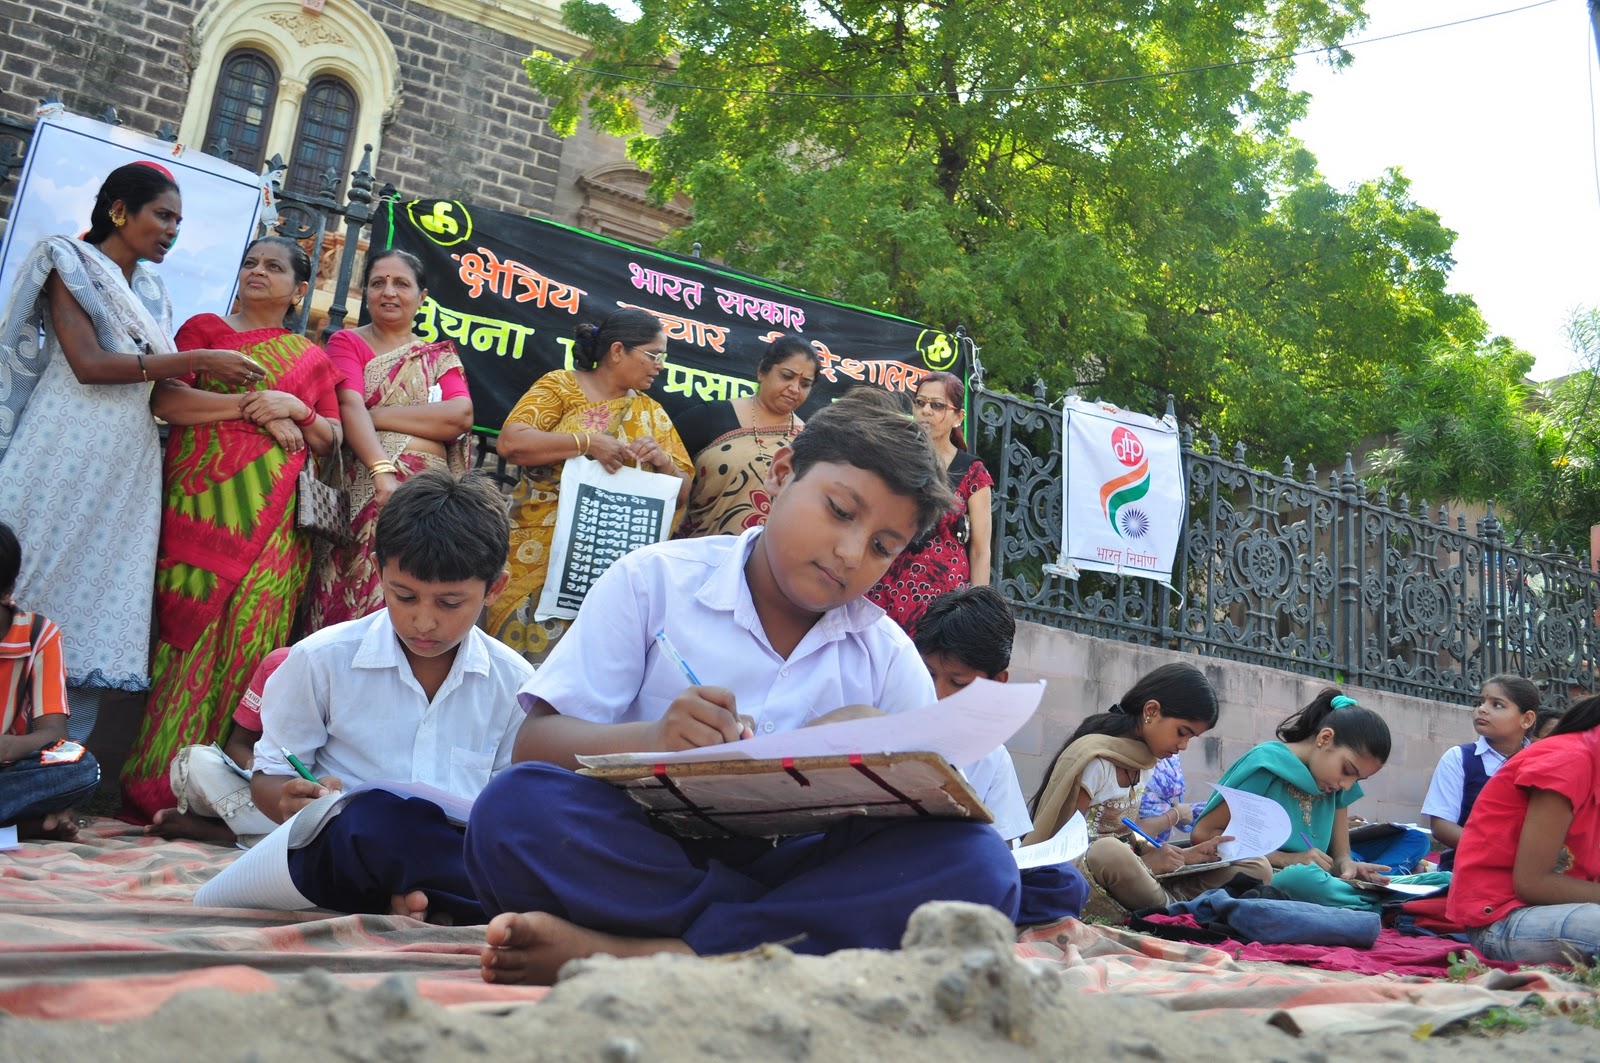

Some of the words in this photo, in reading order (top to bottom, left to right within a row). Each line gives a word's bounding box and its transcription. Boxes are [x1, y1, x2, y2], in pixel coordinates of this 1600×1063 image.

[629, 262, 704, 310] भारत
[714, 287, 805, 332] सरकार
[1114, 431, 1142, 462] dfp
[1126, 548, 1157, 569] निर्माण
